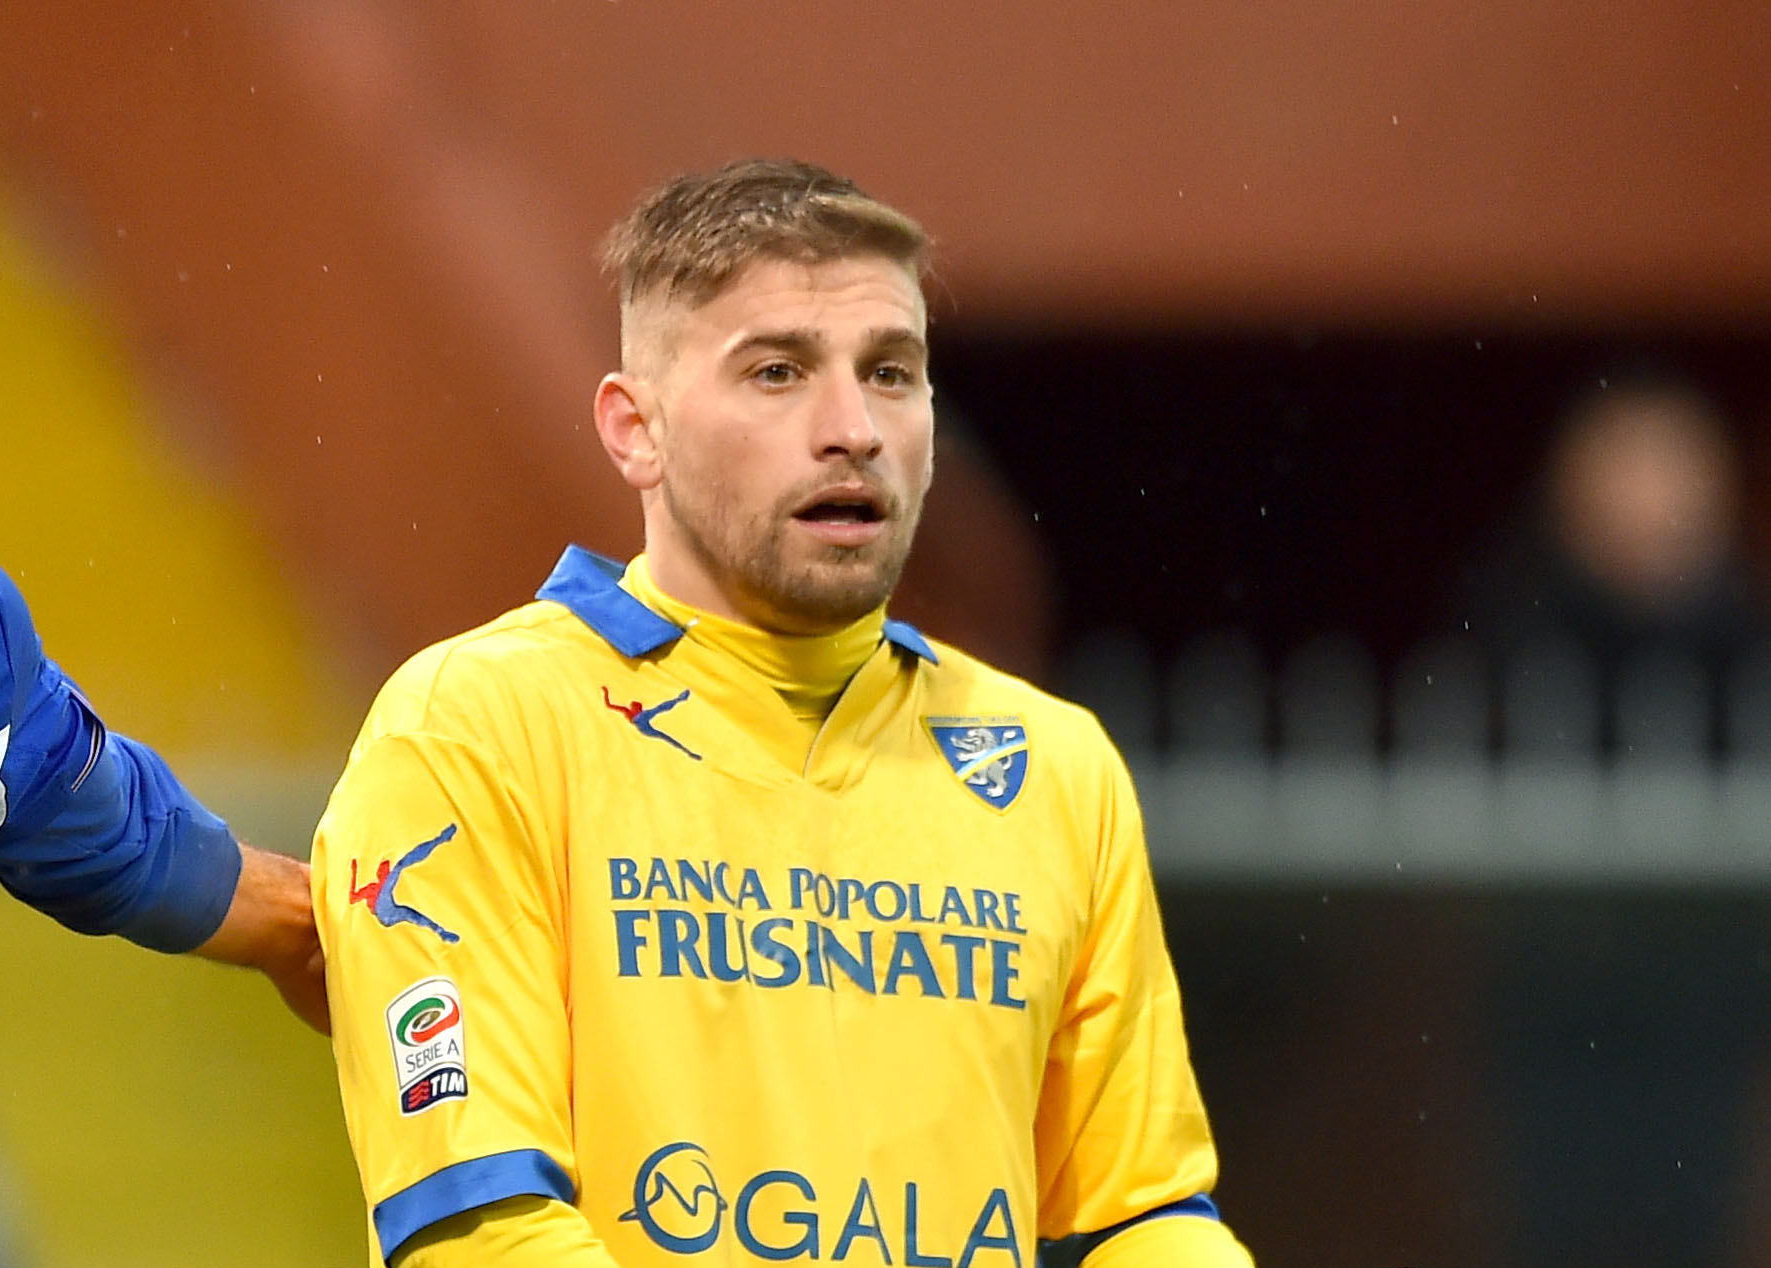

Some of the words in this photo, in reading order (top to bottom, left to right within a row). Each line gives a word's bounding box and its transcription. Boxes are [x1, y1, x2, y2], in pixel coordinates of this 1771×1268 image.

[607, 857, 773, 911] BANCA
[789, 868, 1028, 935] POPOLARE
[611, 909, 1027, 1010] FRUSINATE
[405, 1041, 444, 1073] SERIE
[447, 1038, 460, 1056] A
[430, 1072, 465, 1097] TIM
